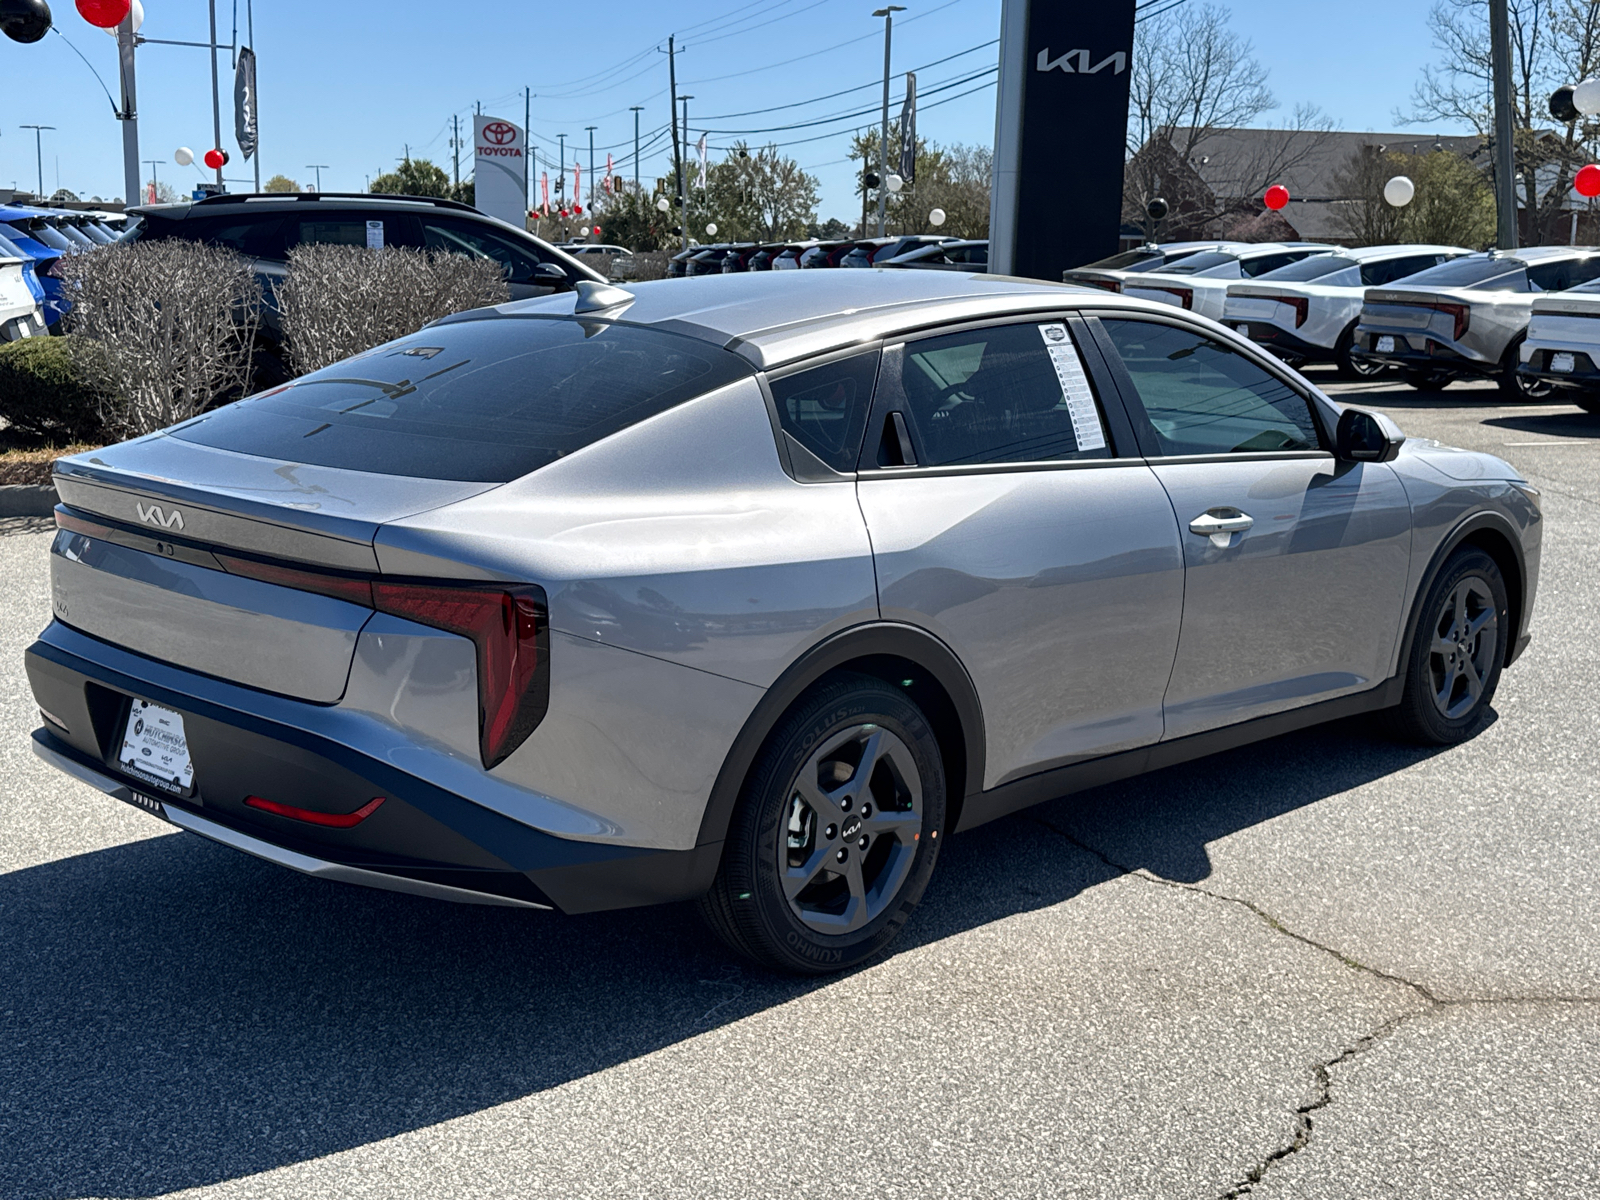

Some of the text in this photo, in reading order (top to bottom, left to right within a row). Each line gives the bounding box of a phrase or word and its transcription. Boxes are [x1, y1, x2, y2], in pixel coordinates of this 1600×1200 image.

[1036, 47, 1126, 76] KIA
[477, 146, 522, 158] TOYOTA
[136, 501, 186, 531] KIA
[143, 737, 169, 751] AUTOMOTIVE
[170, 746, 186, 756] GROUP
[793, 706, 848, 761] SOLUS
[842, 821, 861, 838] KIA
[786, 931, 843, 962] KUMHO
